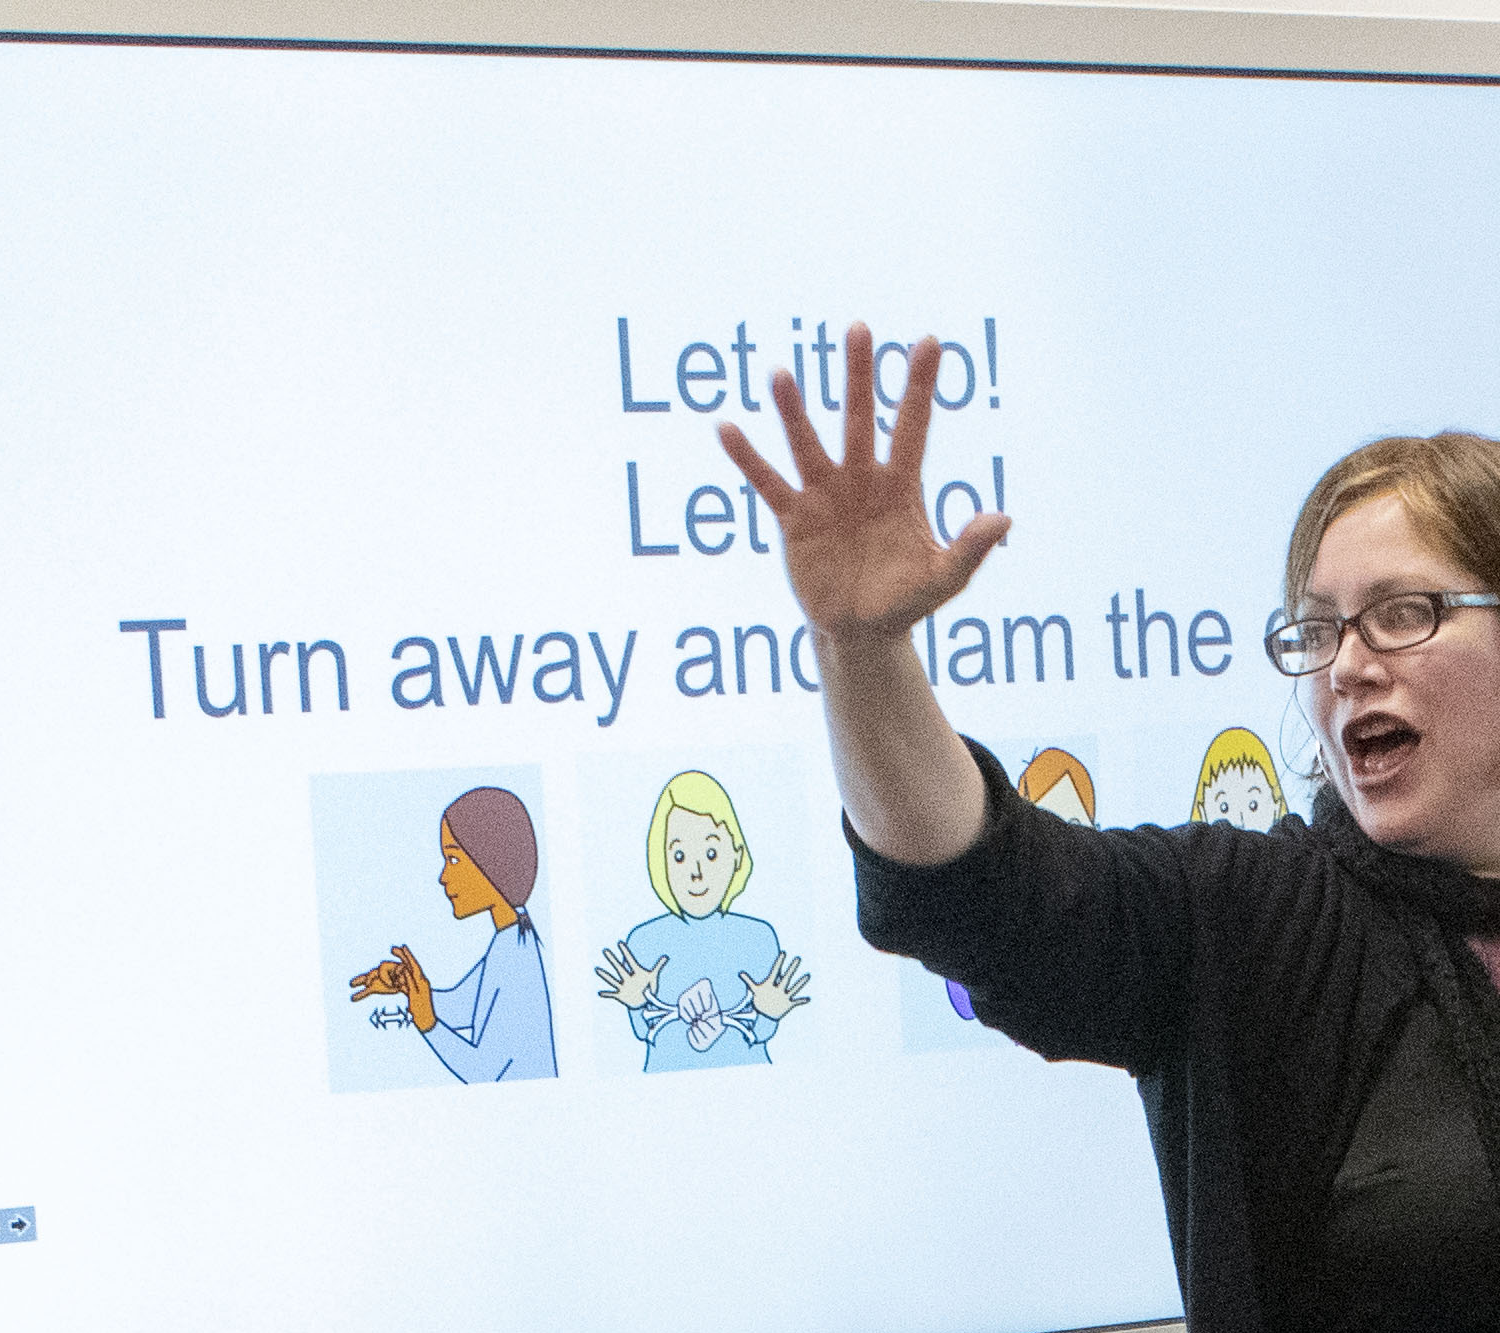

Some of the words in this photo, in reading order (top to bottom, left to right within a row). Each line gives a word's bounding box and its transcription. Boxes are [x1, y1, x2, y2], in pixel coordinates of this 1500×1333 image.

[616, 316, 762, 414] Let
[626, 460, 771, 557] Let
[117, 619, 351, 721] Turn
[389, 626, 638, 729] away
[924, 612, 1077, 688] lam
[1105, 587, 1233, 679] the
